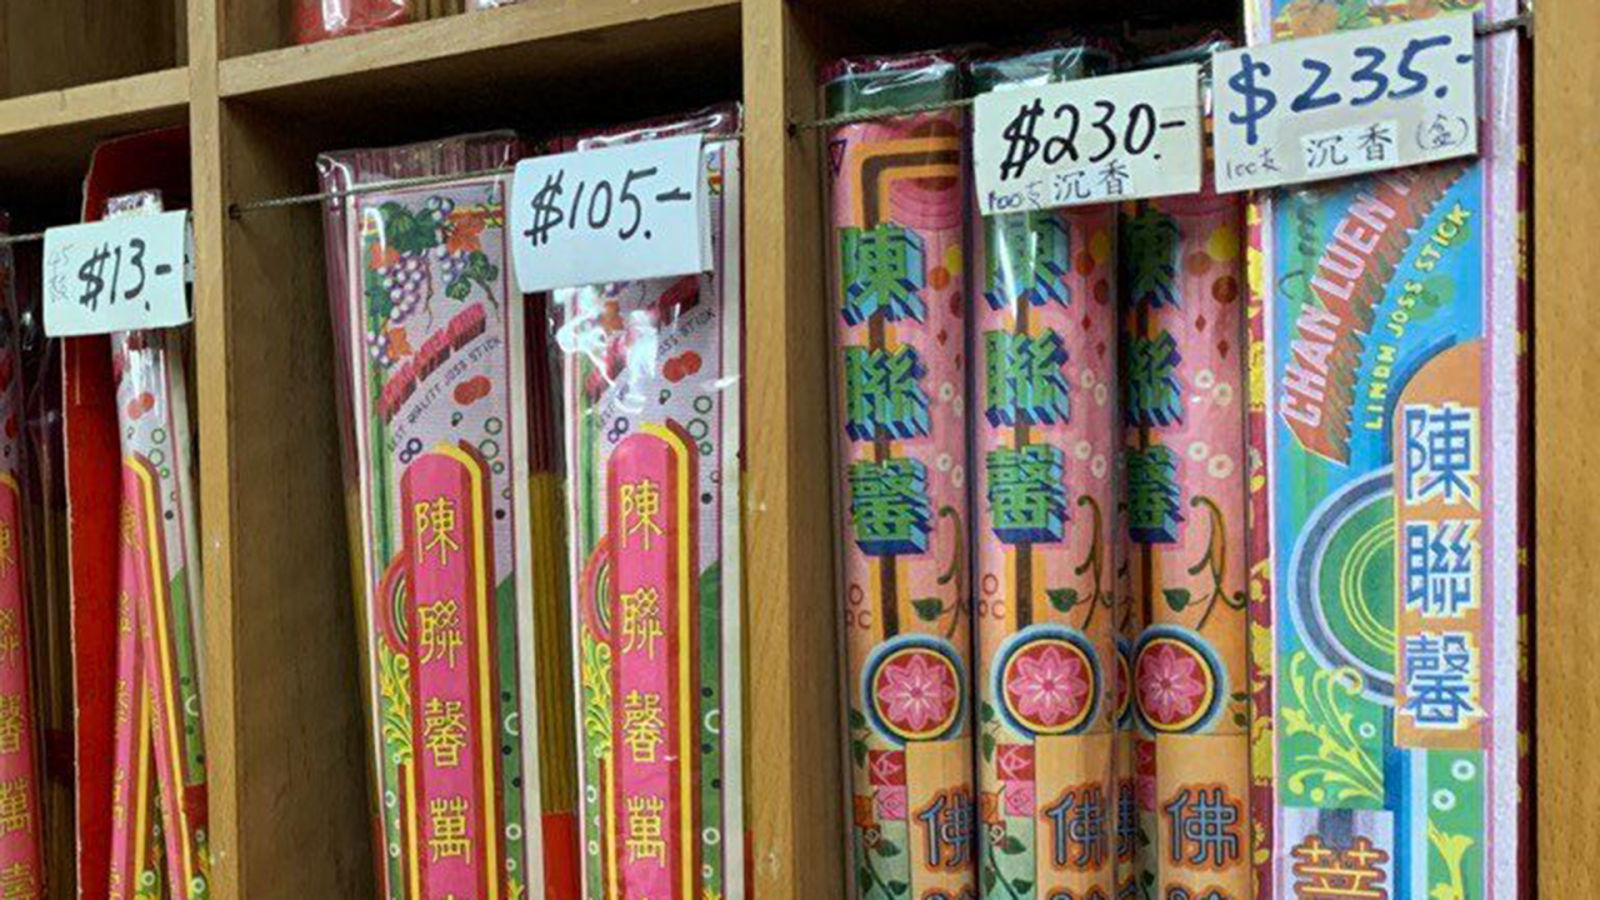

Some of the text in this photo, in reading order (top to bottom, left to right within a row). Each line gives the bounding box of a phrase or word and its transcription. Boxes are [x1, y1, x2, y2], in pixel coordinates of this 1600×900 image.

[1000, 98, 1187, 181] $230.-
[1229, 34, 1474, 146] $235.-
[1306, 123, 1393, 168] 沉香
[524, 166, 692, 246] $105.-
[1053, 159, 1130, 201] 沉香
[1279, 302, 1341, 428] CHAN
[1310, 191, 1396, 301] LUEN
[1387, 280, 1422, 337] JOSS
[1414, 201, 1472, 272] STICK
[841, 222, 932, 556] 陳聯馨
[1404, 405, 1476, 725] 陳聯馨
[414, 496, 471, 864] 陳聯馨萬
[619, 479, 666, 868] 陳聯馨萬
[1164, 787, 1240, 868] 佛
